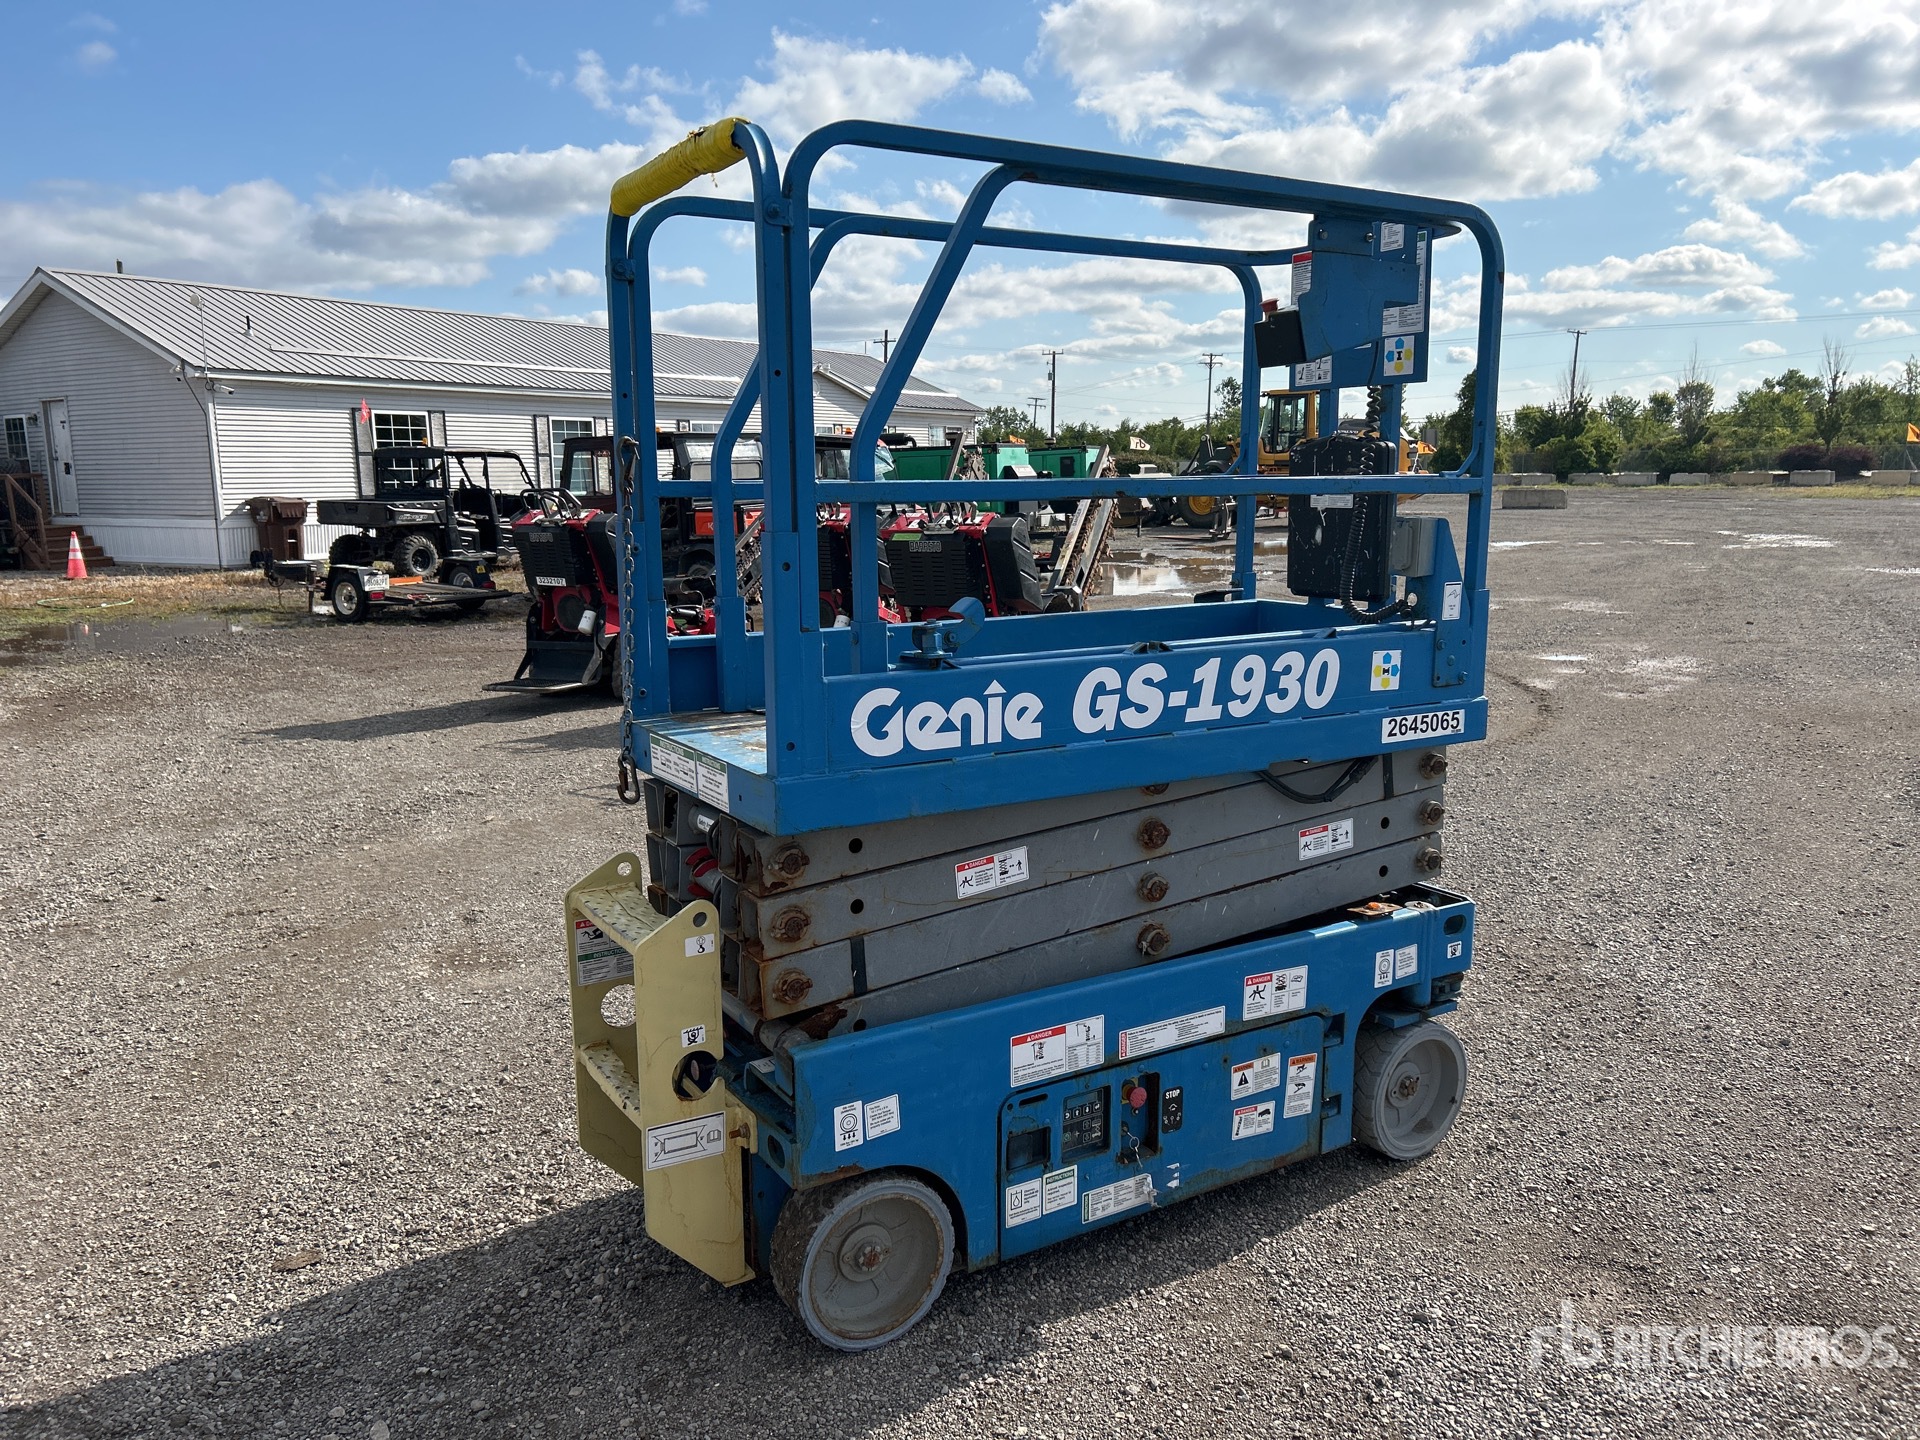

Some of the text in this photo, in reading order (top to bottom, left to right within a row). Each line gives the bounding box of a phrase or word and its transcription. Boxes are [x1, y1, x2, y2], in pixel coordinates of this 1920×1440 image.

[1135, 439, 1147, 448] rb
[909, 541, 942, 552] BARRETO
[538, 577, 564, 585] 3232107
[1072, 649, 1340, 733] GS-1930
[1387, 711, 1460, 737] 2645065
[969, 859, 987, 868] DANGER
[593, 948, 626, 958] INSTRUCTION
[1030, 1030, 1053, 1040] DANGER
[1165, 1089, 1181, 1099] STOP
[1046, 1170, 1074, 1183] INSTRUCTIONS
